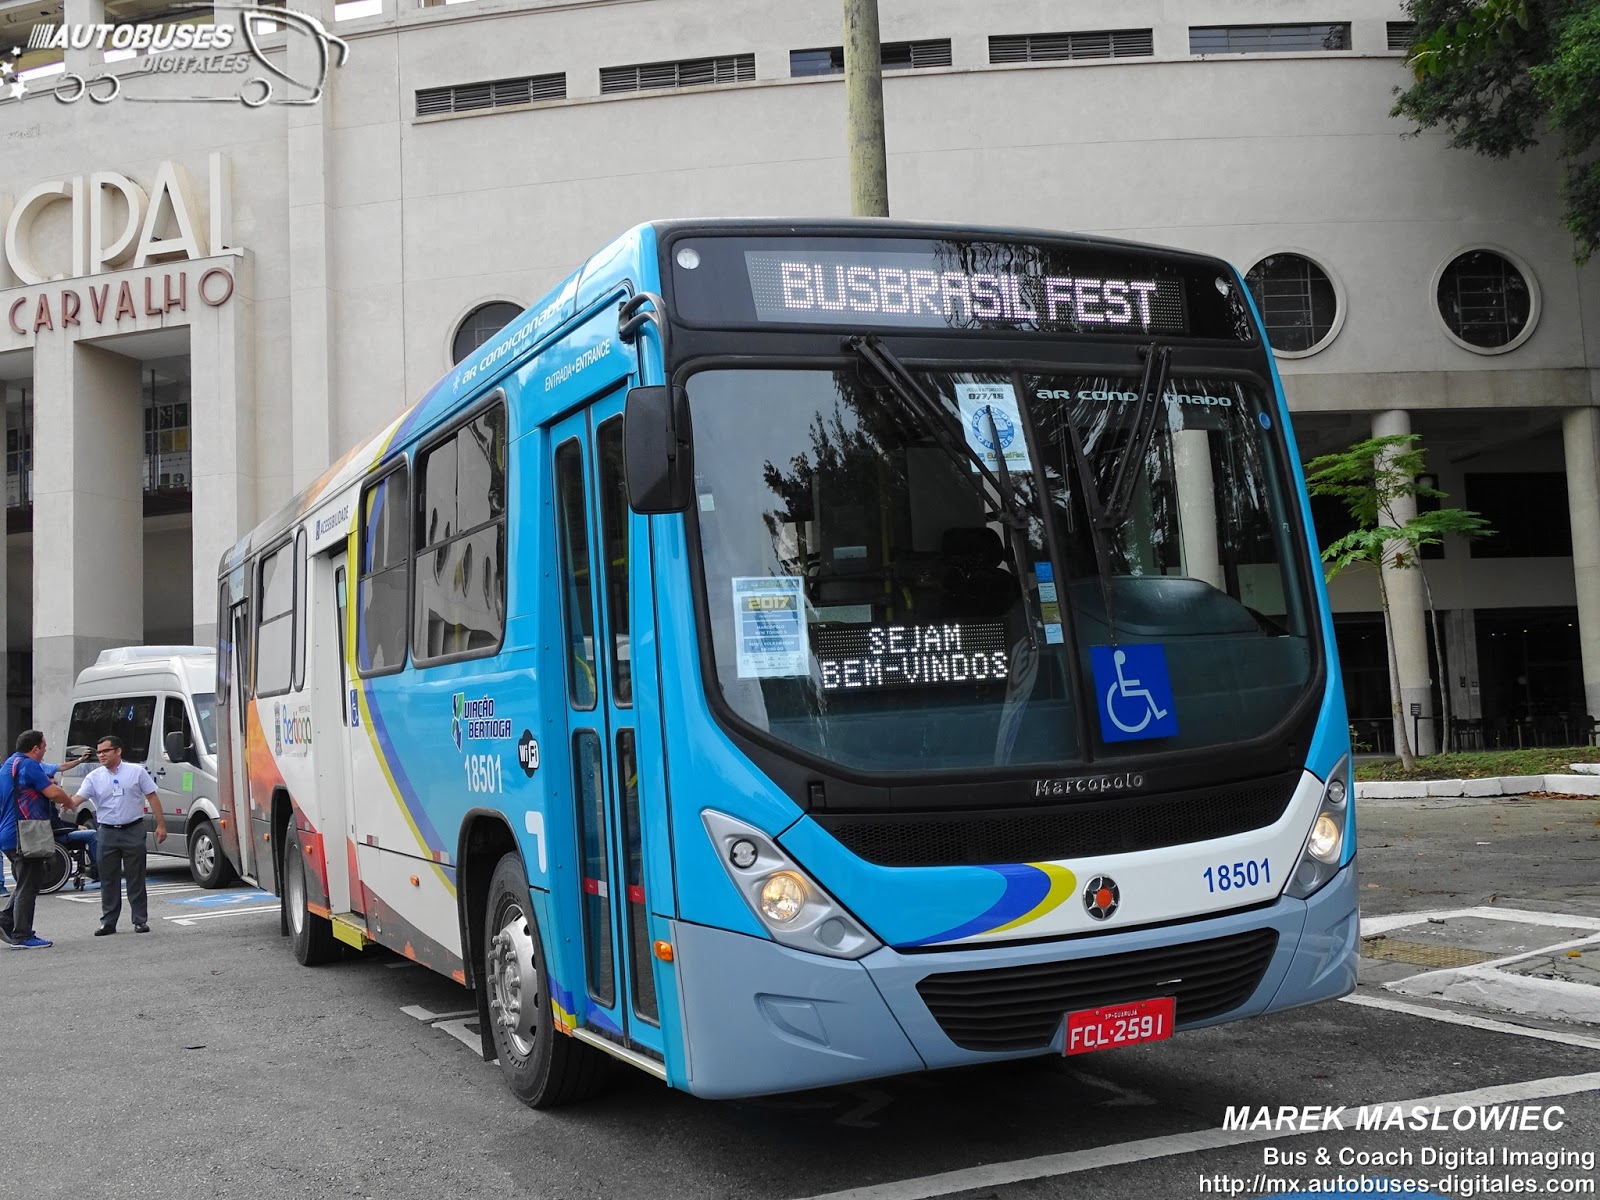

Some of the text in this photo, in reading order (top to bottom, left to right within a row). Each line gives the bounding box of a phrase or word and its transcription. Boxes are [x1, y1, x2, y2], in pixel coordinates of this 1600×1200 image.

[8, 267, 234, 335] CARVALHO
[781, 262, 1157, 324] BUSBRASIL FEST
[575, 338, 611, 373] ENTRANCE
[748, 596, 790, 610] 2017
[869, 623, 962, 655] SEJAM
[822, 651, 1009, 689] BEM-VINDOS
[463, 693, 495, 720] VIAÇÃO
[468, 719, 512, 739] BERTIOGA
[464, 754, 503, 793] 18501
[1034, 773, 1144, 797] Marcopolo
[1203, 857, 1271, 893] 18501
